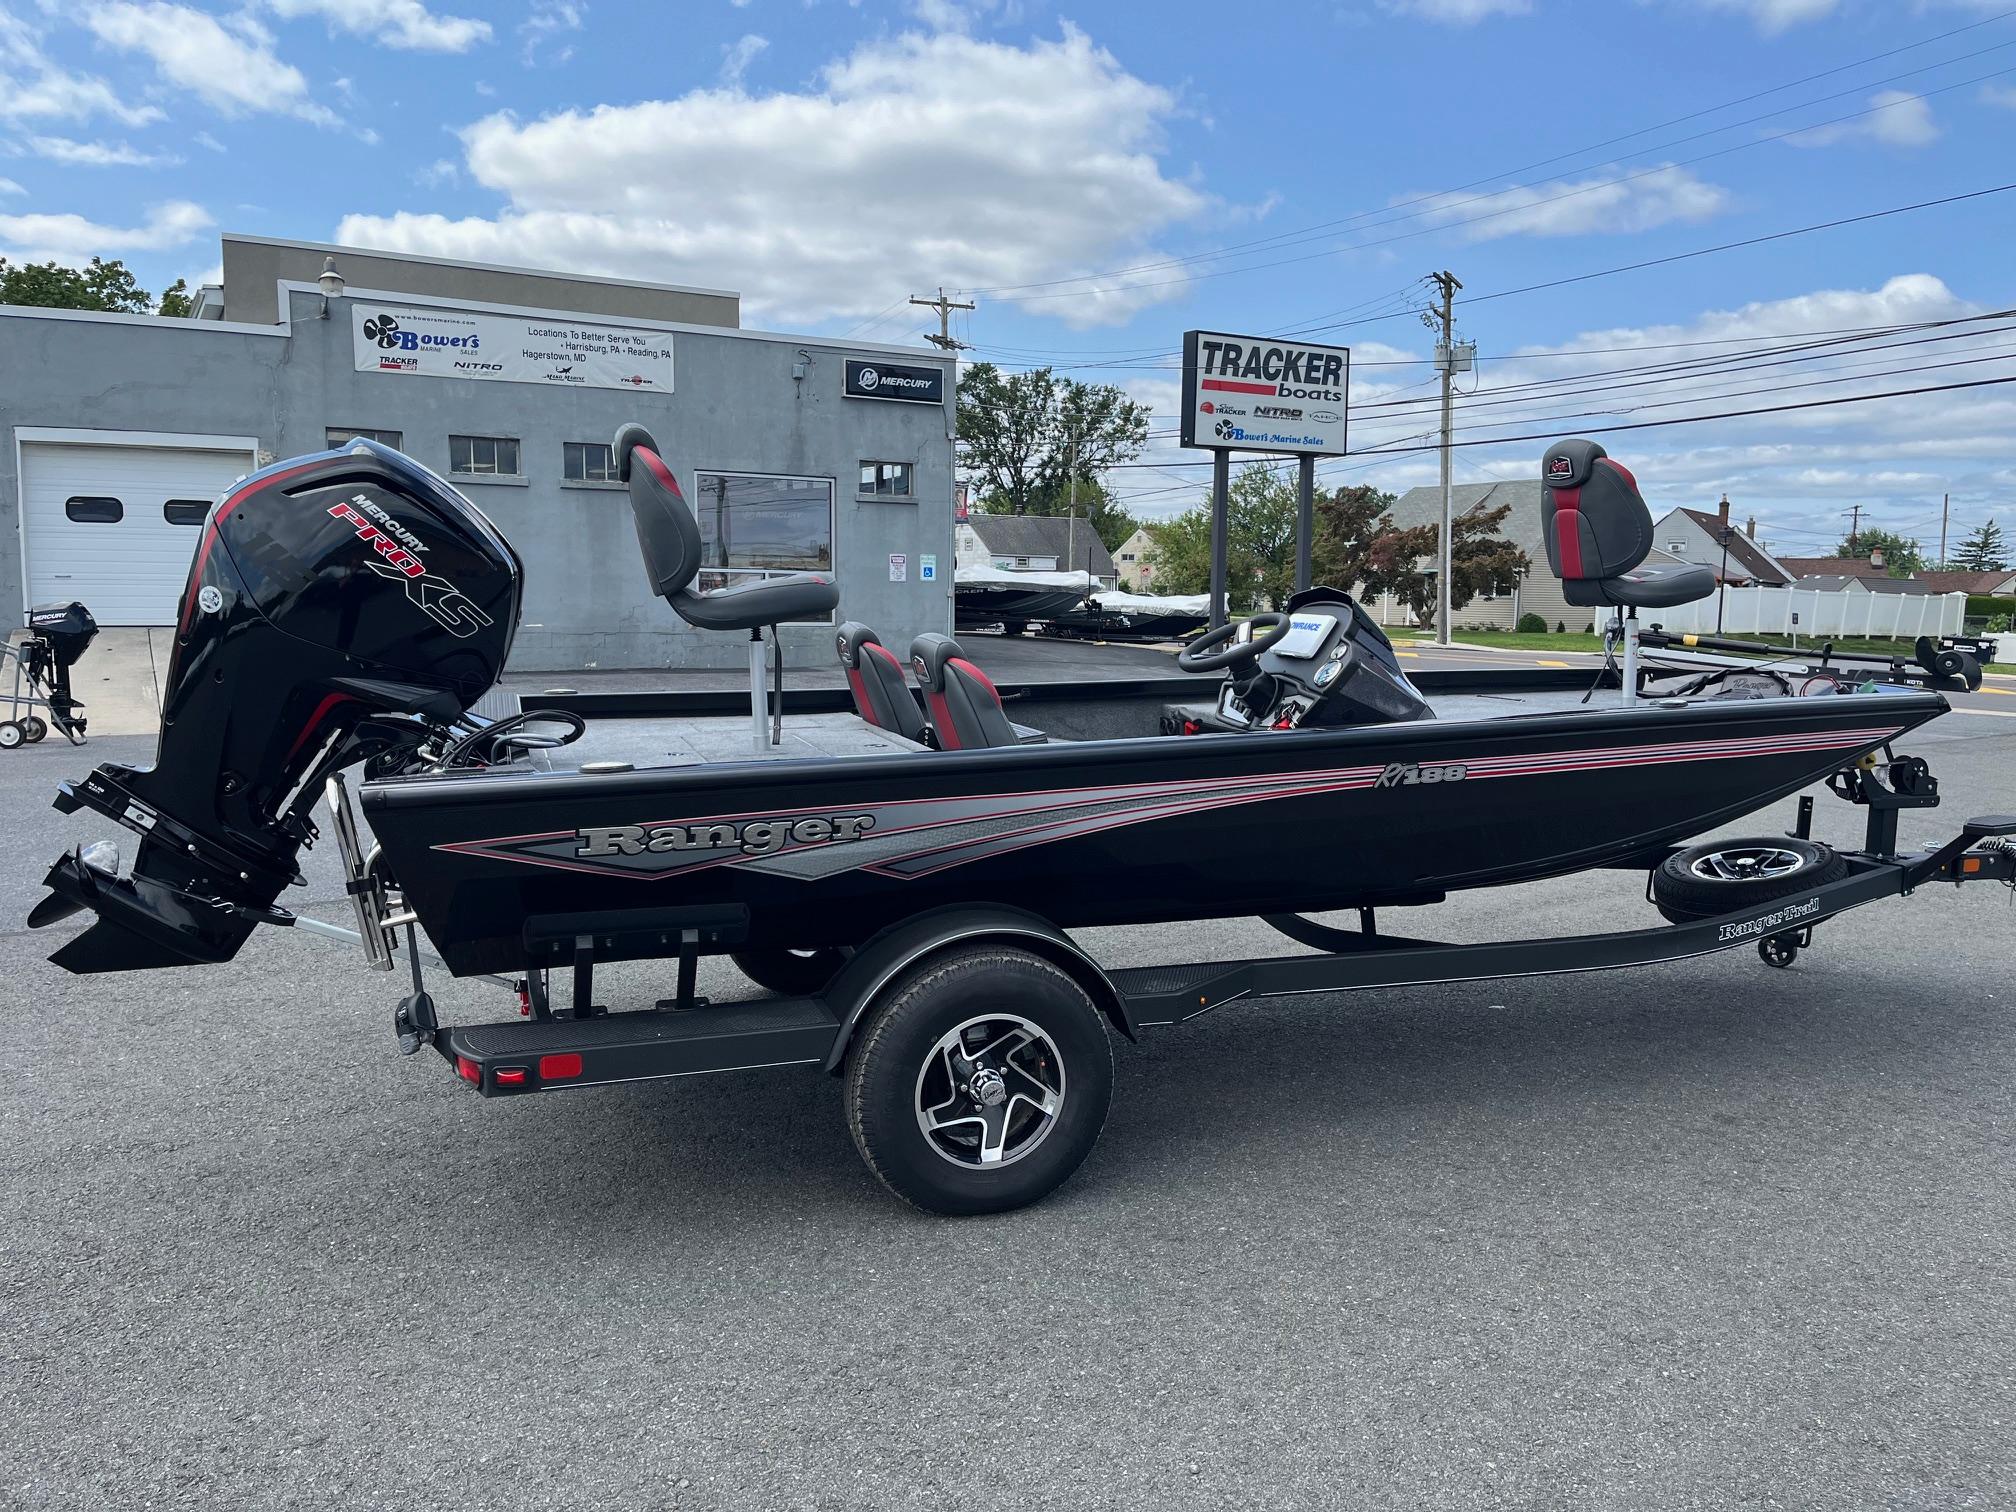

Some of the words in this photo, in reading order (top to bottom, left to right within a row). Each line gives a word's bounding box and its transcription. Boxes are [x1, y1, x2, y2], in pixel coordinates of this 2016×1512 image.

[528, 327, 567, 339] Locations
[570, 331, 580, 340] To
[581, 332, 605, 342] Better
[608, 334, 630, 345] Serve
[632, 336, 646, 346] You
[522, 349, 572, 362] Hagerstown,
[574, 353, 587, 362] MD
[565, 341, 609, 355] Harrisburg,
[610, 345, 620, 354] PA
[628, 347, 660, 359] Reading,
[661, 350, 671, 359] PA
[380, 356, 418, 365] TRACKER
[454, 361, 503, 371] NITRO
[1202, 341, 1343, 387] TRACKER
[880, 376, 932, 389] MERCURY
[1278, 383, 1342, 402] boats
[1215, 408, 1247, 416] TRACKER
[1254, 405, 1304, 418] NITRO
[1269, 434, 1302, 444] Marine
[1302, 436, 1324, 446] Sales
[352, 494, 430, 553] MERCURY
[326, 502, 427, 579] PRO
[364, 546, 495, 639] XS
[32, 612, 68, 622] MERCURY
[1291, 622, 1321, 631] OWRANCE
[576, 814, 876, 856] Ranger
[1719, 911, 1783, 941] Ranger
[1784, 897, 1819, 921] Trail
